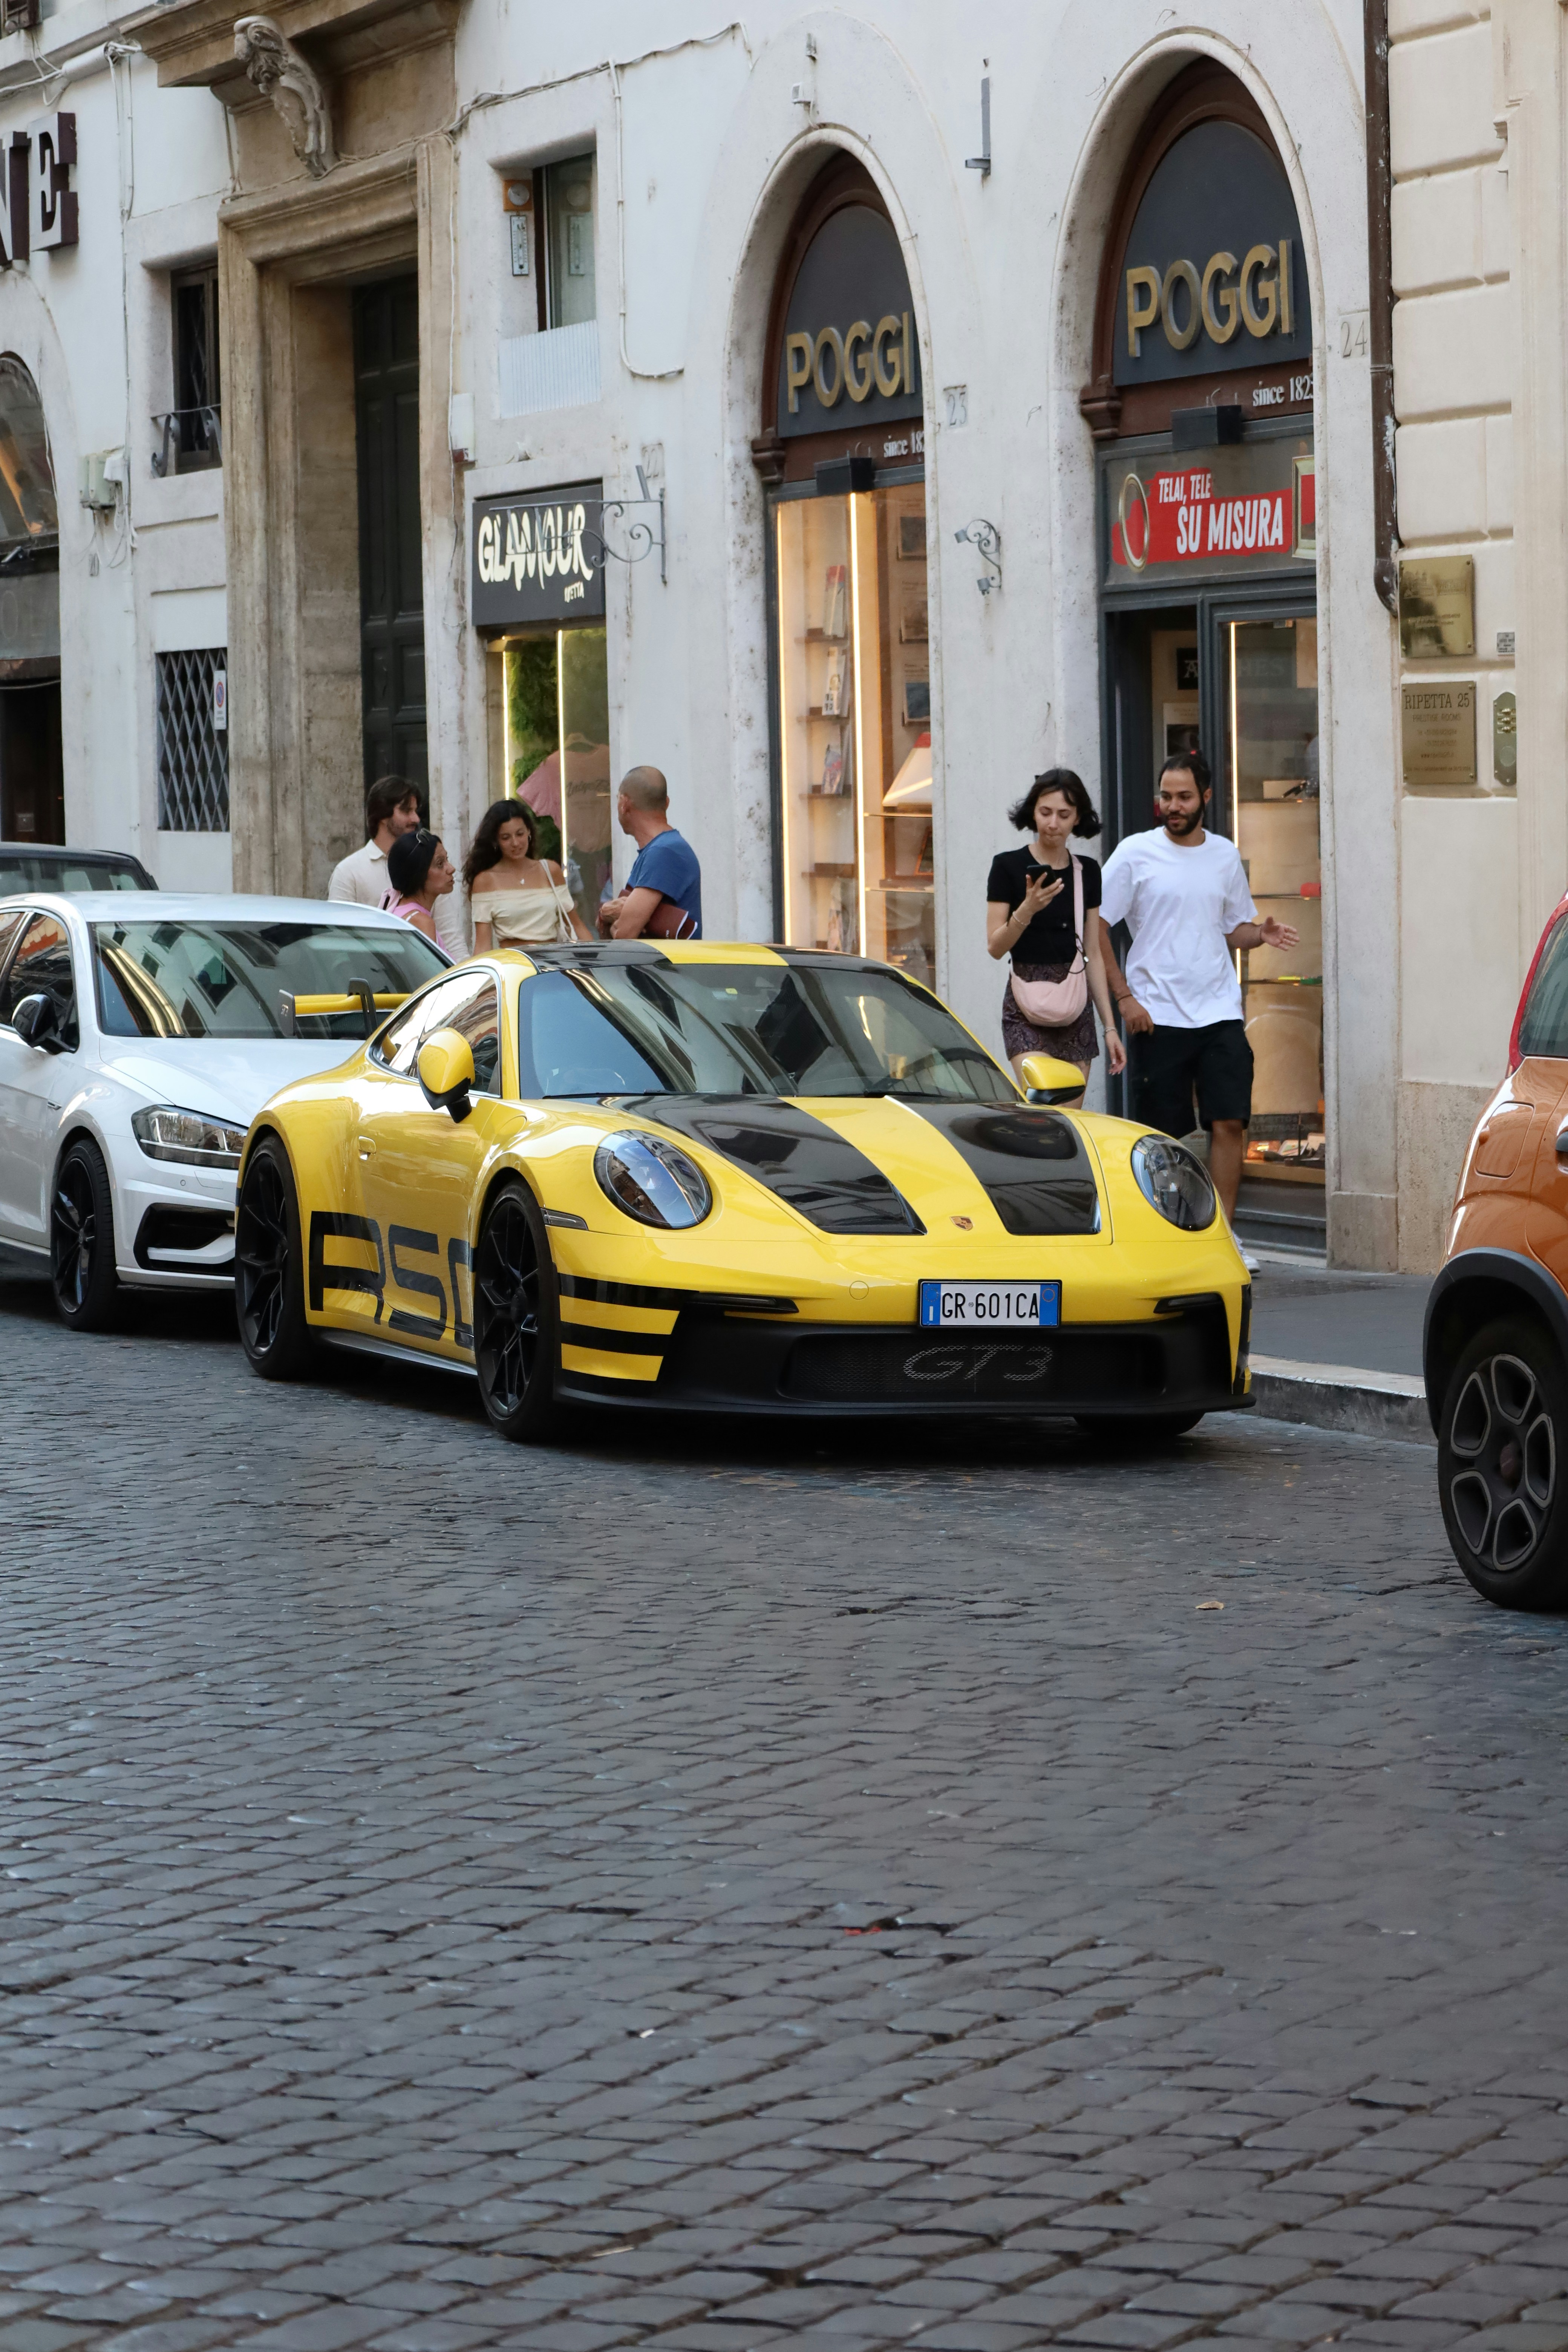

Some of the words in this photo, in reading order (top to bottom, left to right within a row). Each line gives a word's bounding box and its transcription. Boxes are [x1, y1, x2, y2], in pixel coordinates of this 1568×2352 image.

[1126, 239, 1293, 357] POGGI
[1341, 320, 1368, 358] 24
[787, 312, 915, 413] POGGI
[1253, 381, 1285, 407] since
[1290, 371, 1313, 401] 182
[884, 435, 908, 458] since
[1159, 476, 1187, 505] TELAI,
[1190, 473, 1211, 500] TELE
[1176, 505, 1202, 554] SU
[1208, 498, 1283, 551] MISURA
[478, 504, 594, 591] GLAMOUR
[1404, 694, 1452, 710] RIPETTA
[1458, 693, 1470, 708] 25
[903, 1344, 1053, 1380] GT3
